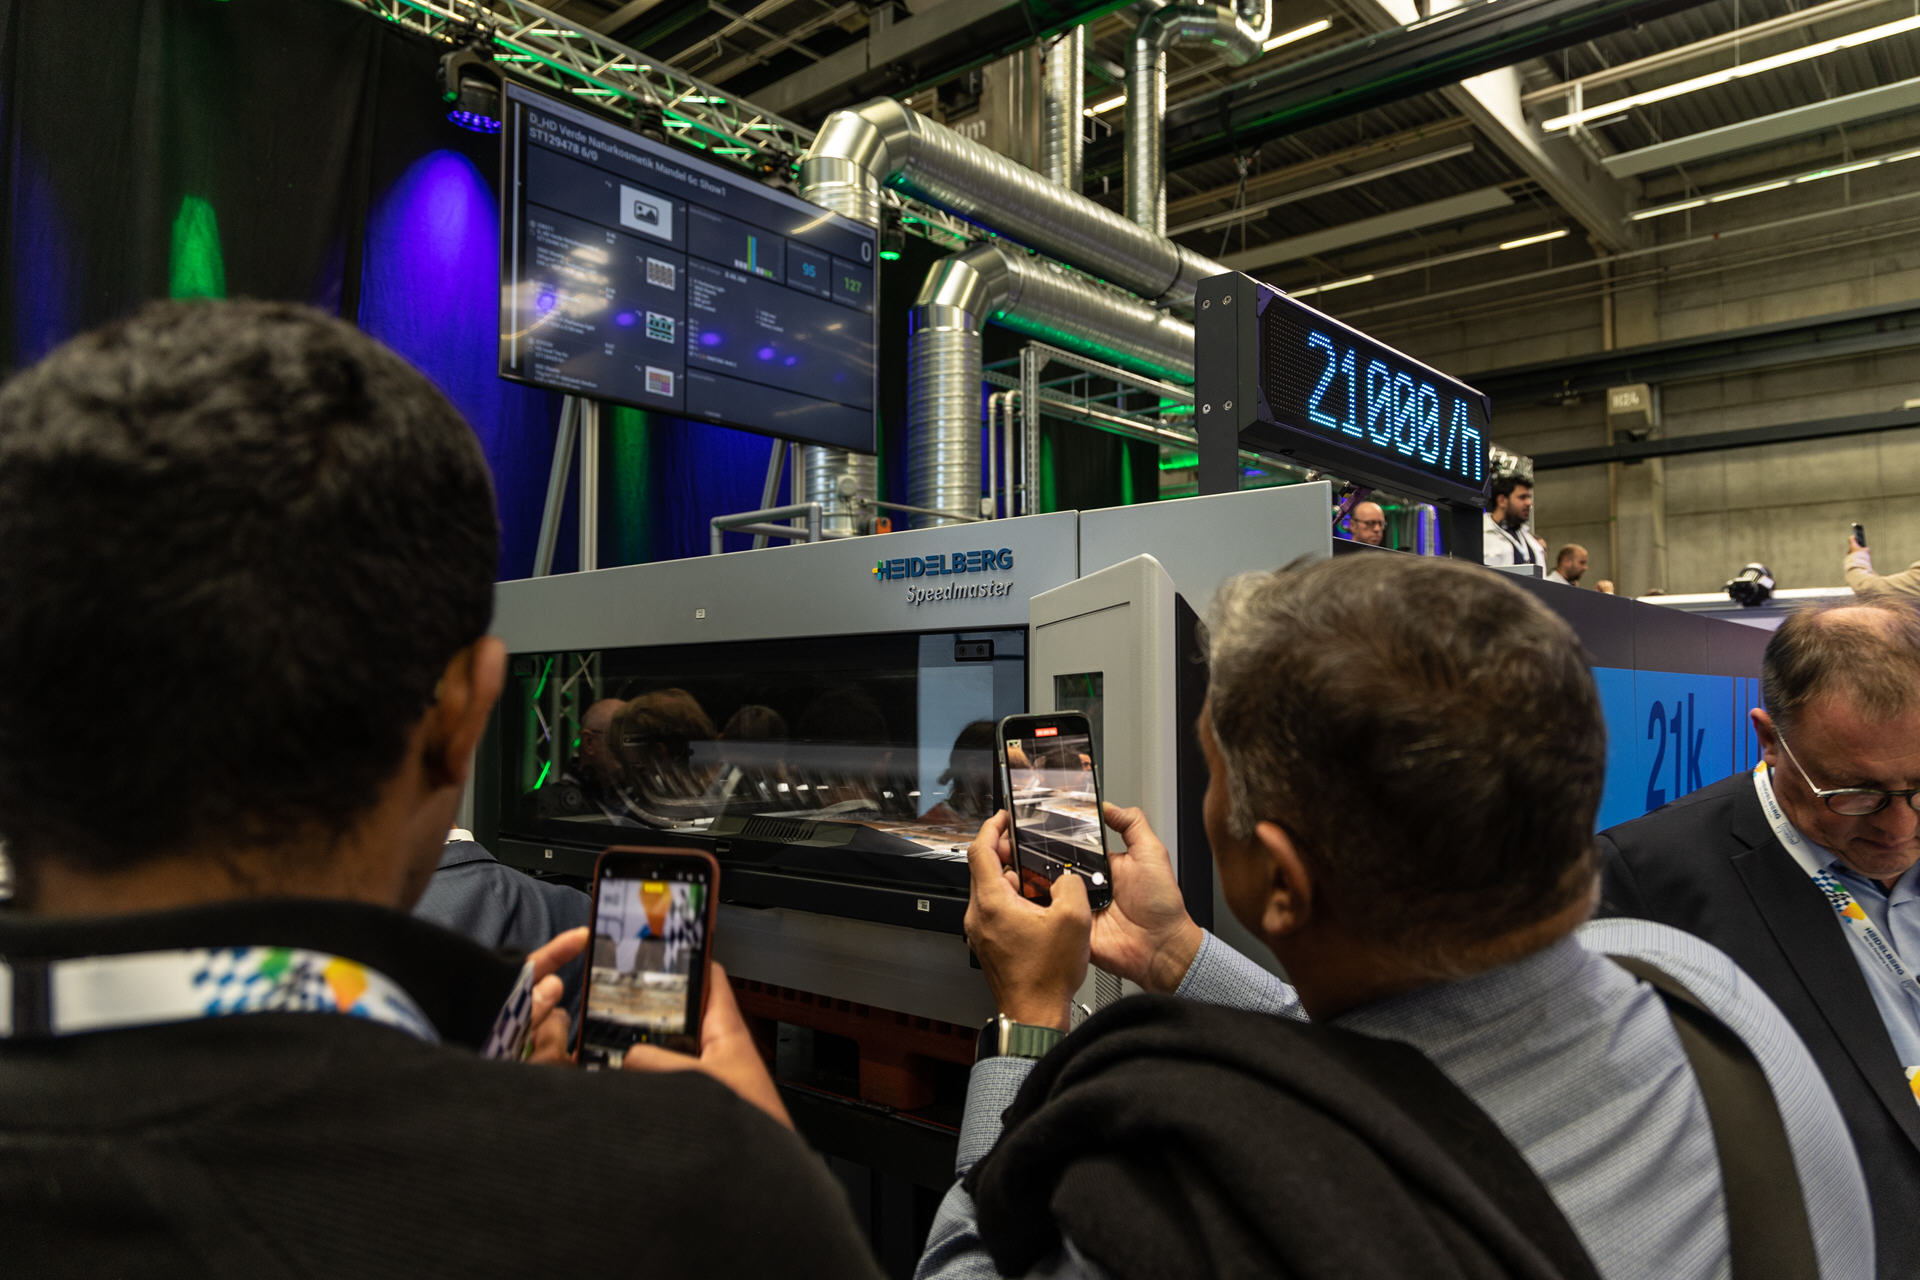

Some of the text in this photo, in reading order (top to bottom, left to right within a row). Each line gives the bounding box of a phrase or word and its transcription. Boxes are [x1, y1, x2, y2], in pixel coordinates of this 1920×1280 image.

[559, 123, 587, 144] Verde
[588, 135, 654, 169] Naturkosmetik
[655, 161, 687, 181] Mandel
[860, 240, 872, 263] 0
[844, 276, 862, 293] 127
[1307, 330, 1483, 482] 21000/h
[872, 547, 1014, 582] HEIDELBERG
[905, 579, 1015, 607] Speedmaster
[1645, 692, 1706, 812] 21k
